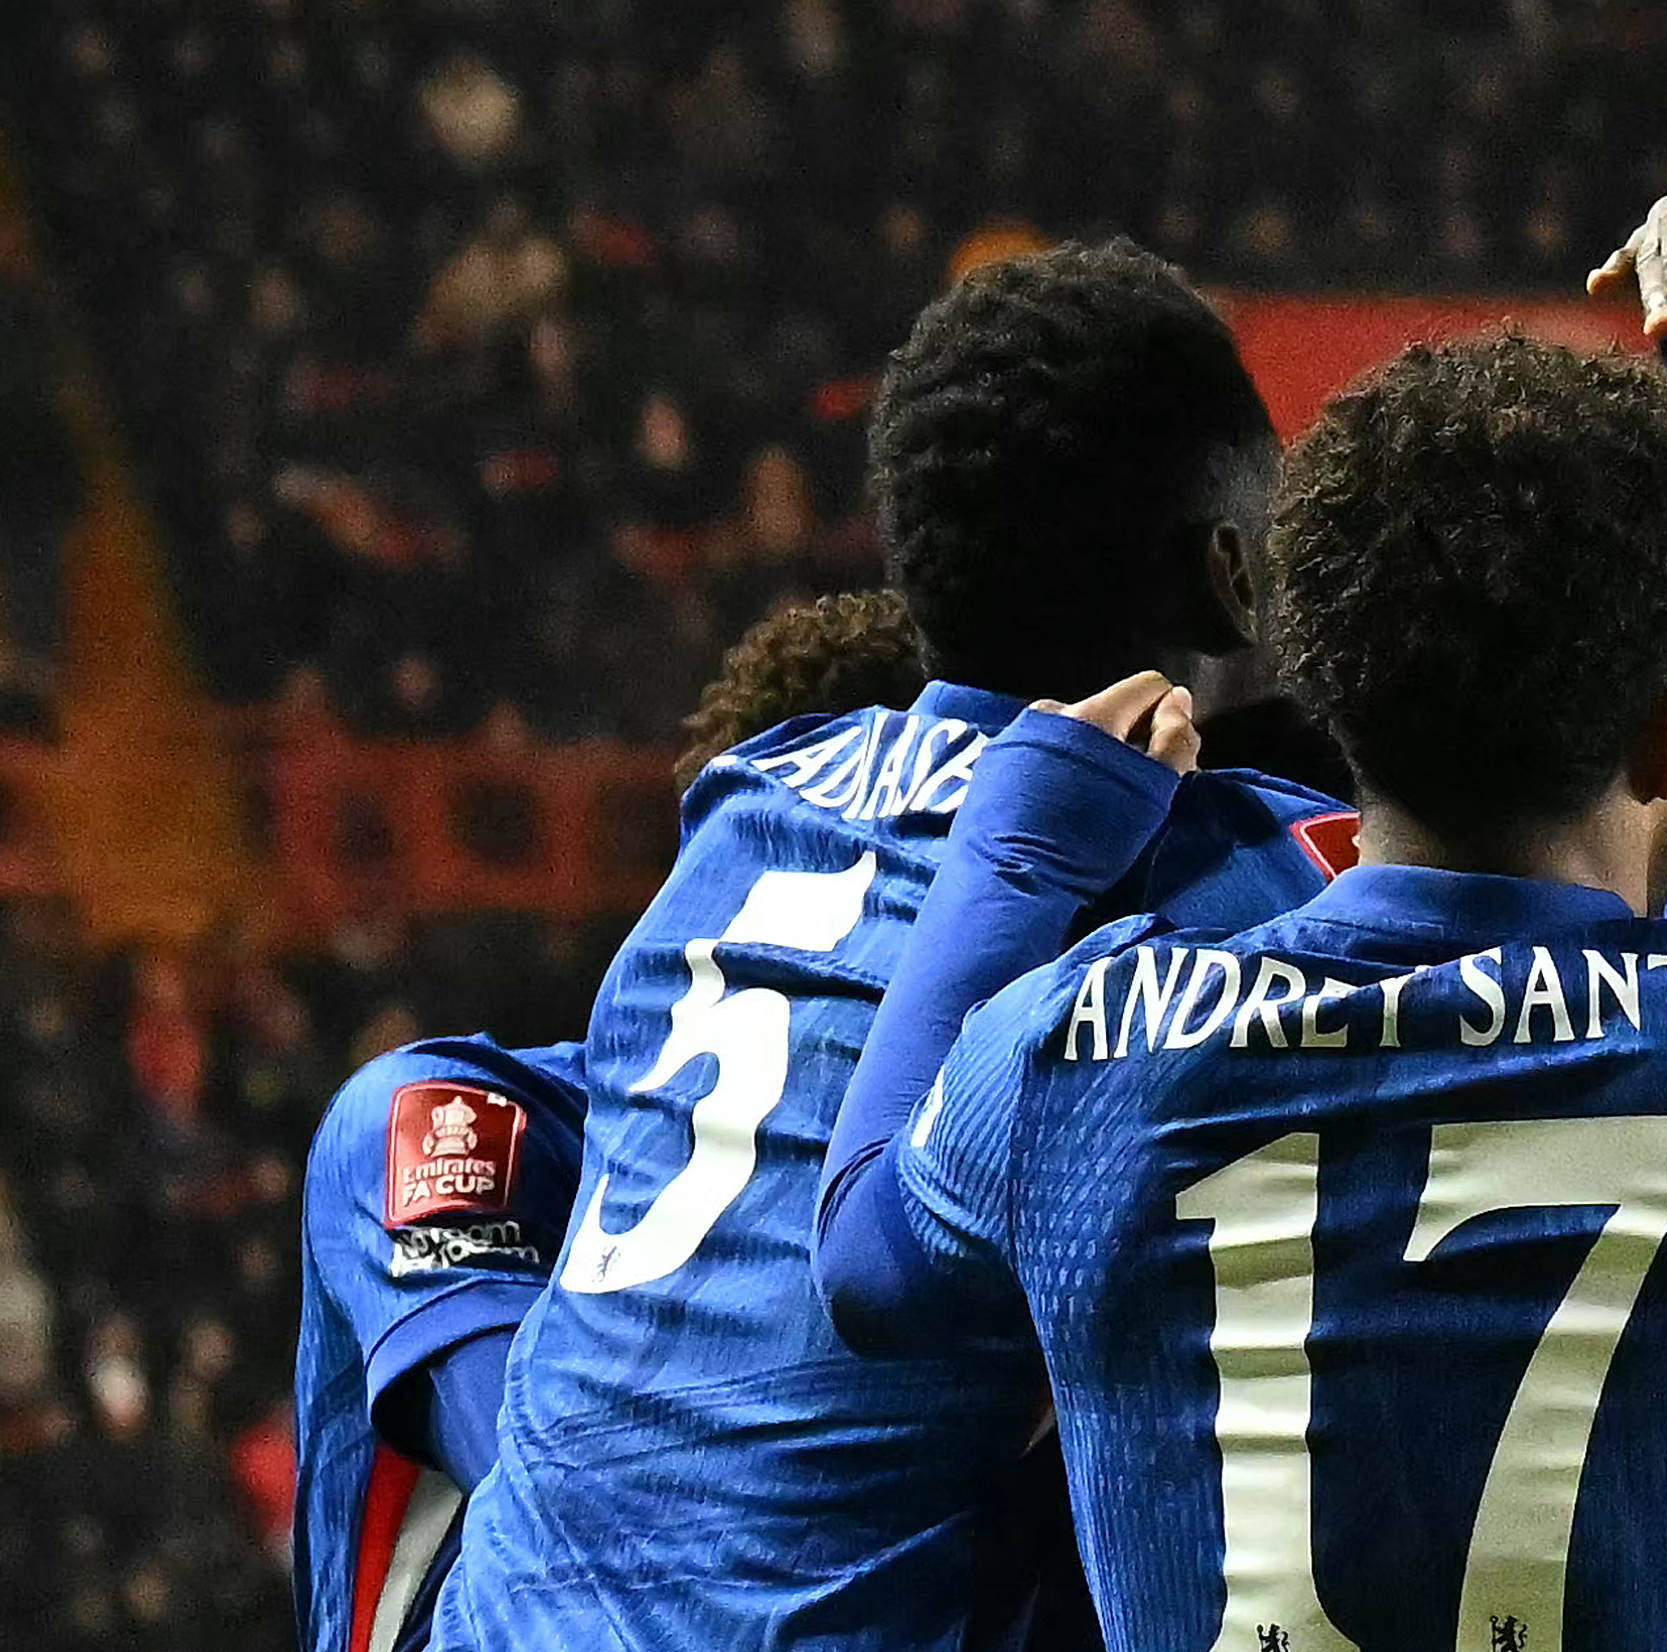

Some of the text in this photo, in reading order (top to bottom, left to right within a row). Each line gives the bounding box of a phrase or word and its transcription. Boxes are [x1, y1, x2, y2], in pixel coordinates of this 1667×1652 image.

[1064, 946, 1430, 1062] ANDREY
[560, 850, 877, 1294] 5
[403, 1157, 496, 1185] Emirates
[403, 1174, 496, 1207] FA CUP
